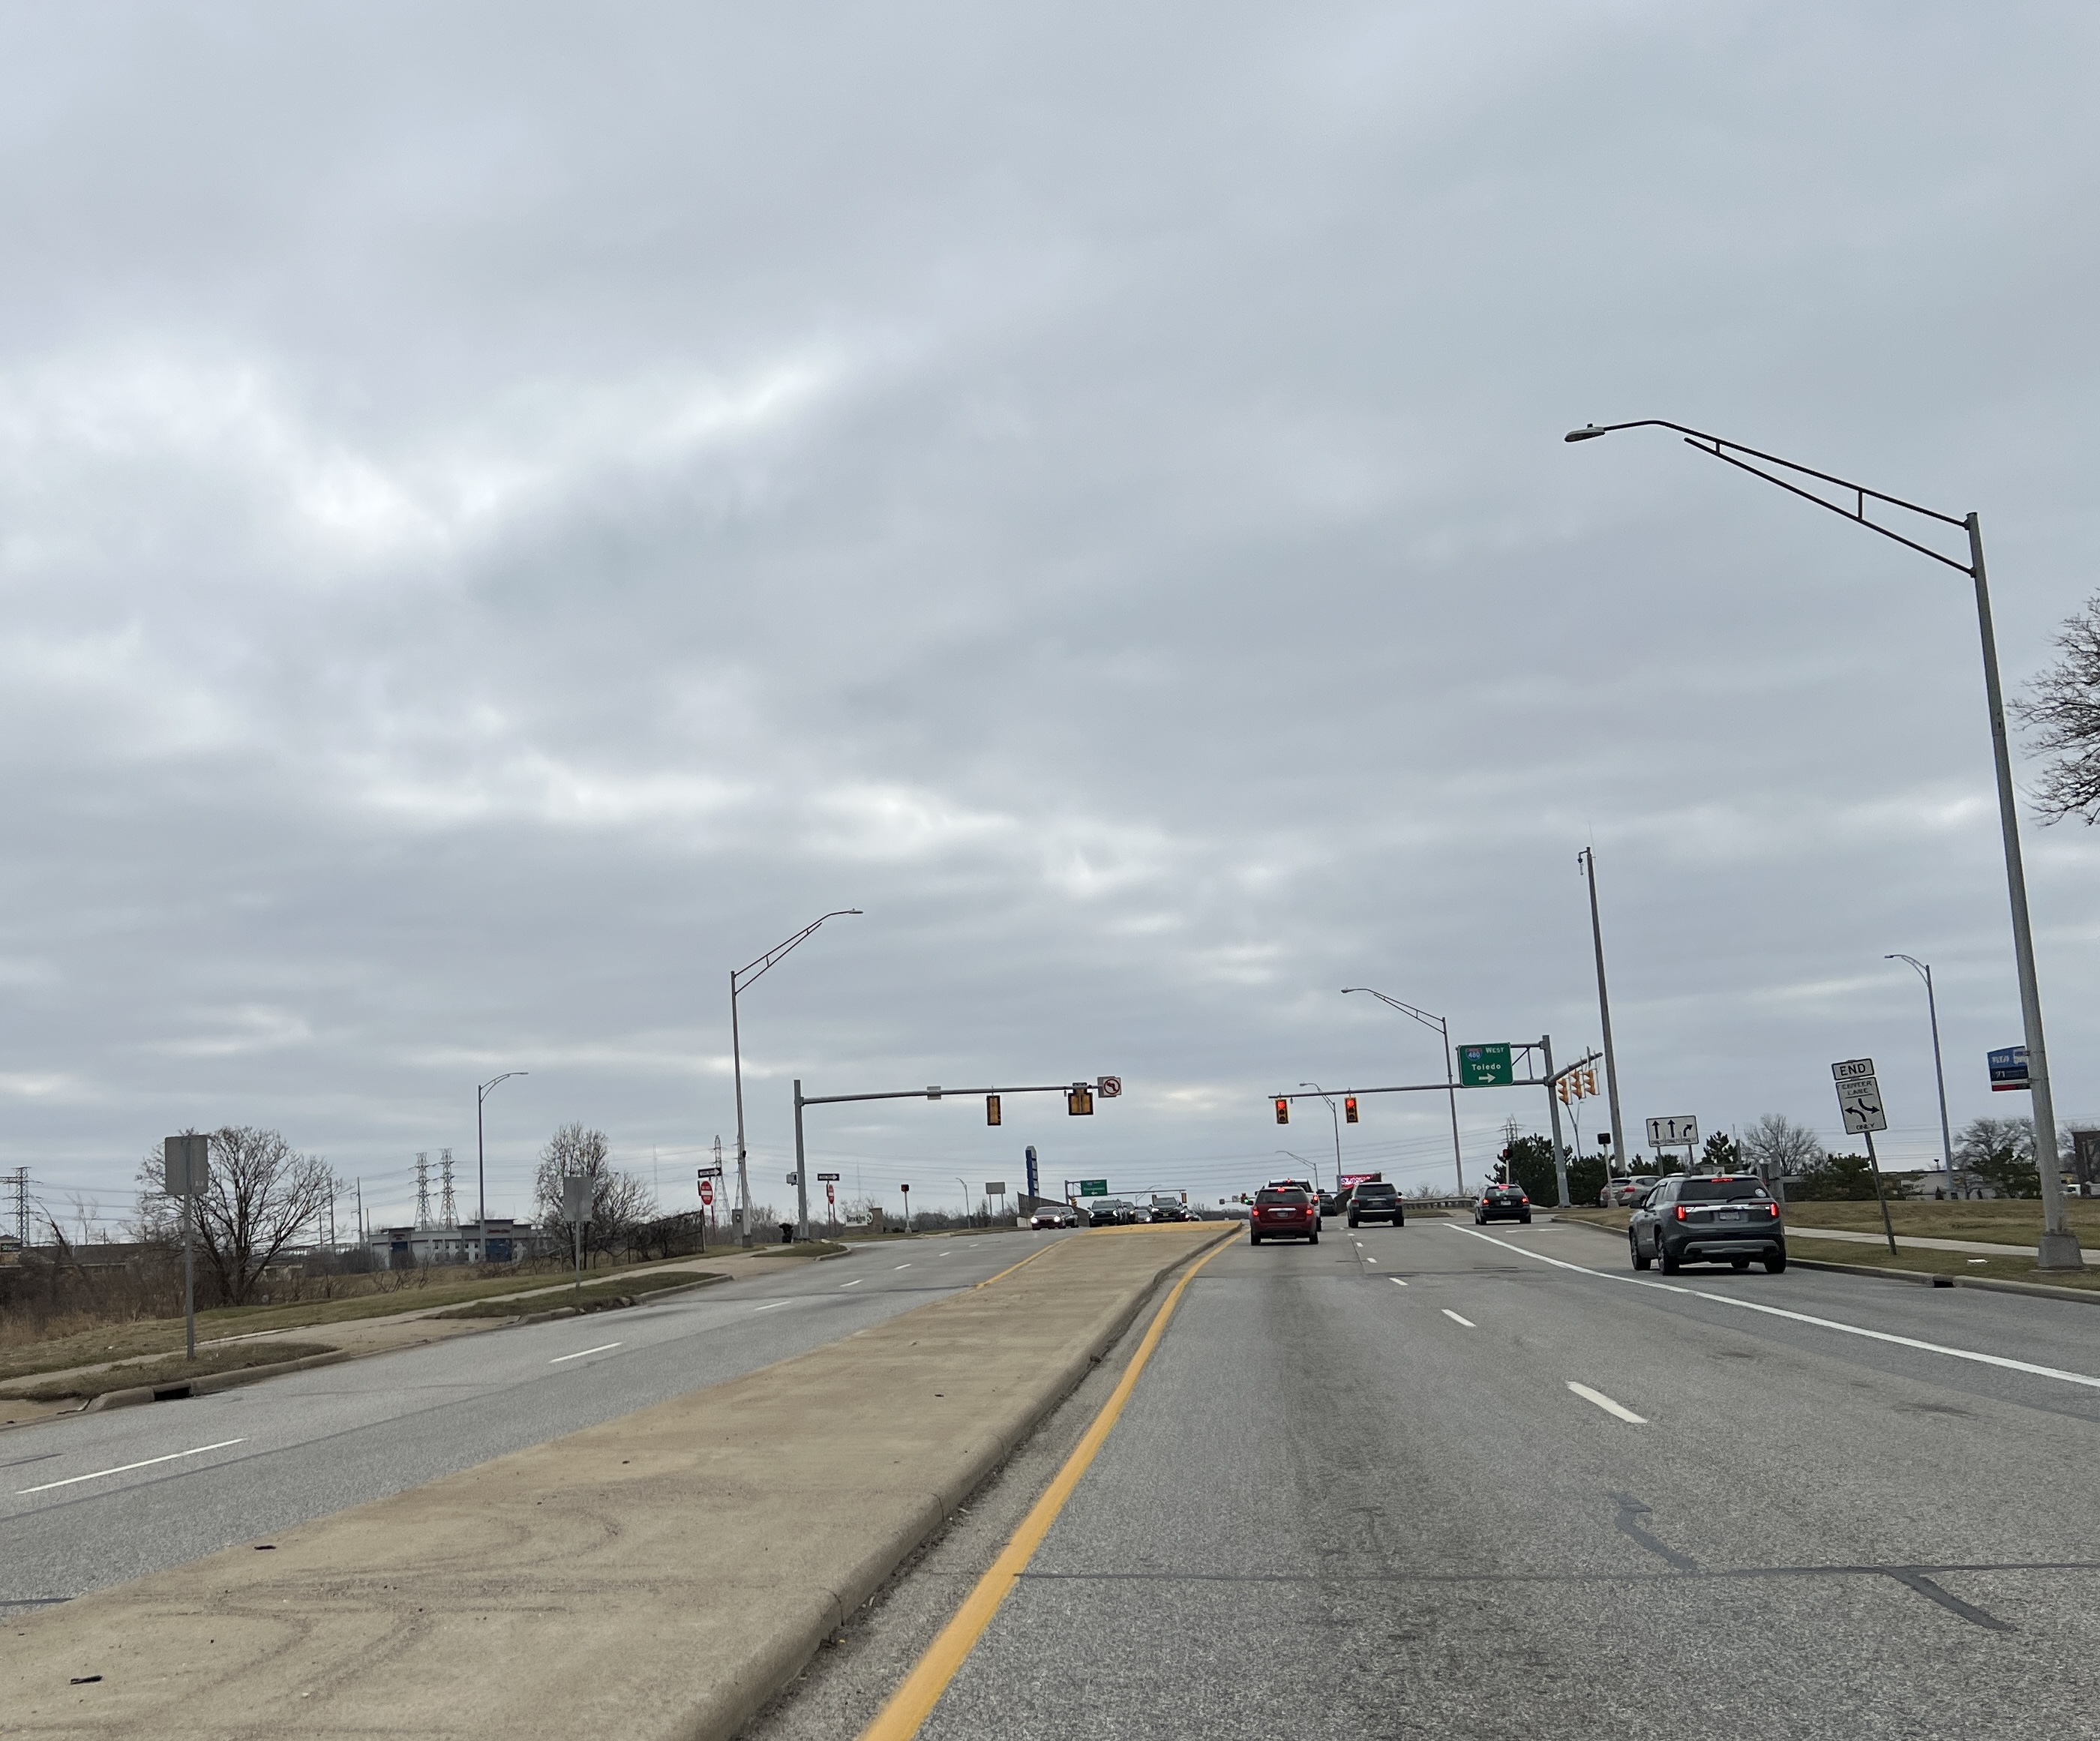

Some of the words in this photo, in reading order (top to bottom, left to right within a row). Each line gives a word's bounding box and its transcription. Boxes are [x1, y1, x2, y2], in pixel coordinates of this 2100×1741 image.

[1472, 1063, 1502, 1071] Toledo
[1839, 1063, 1866, 1076] END
[1841, 1079, 1873, 1090] CENTER
[1847, 1088, 1869, 1096] LANE
